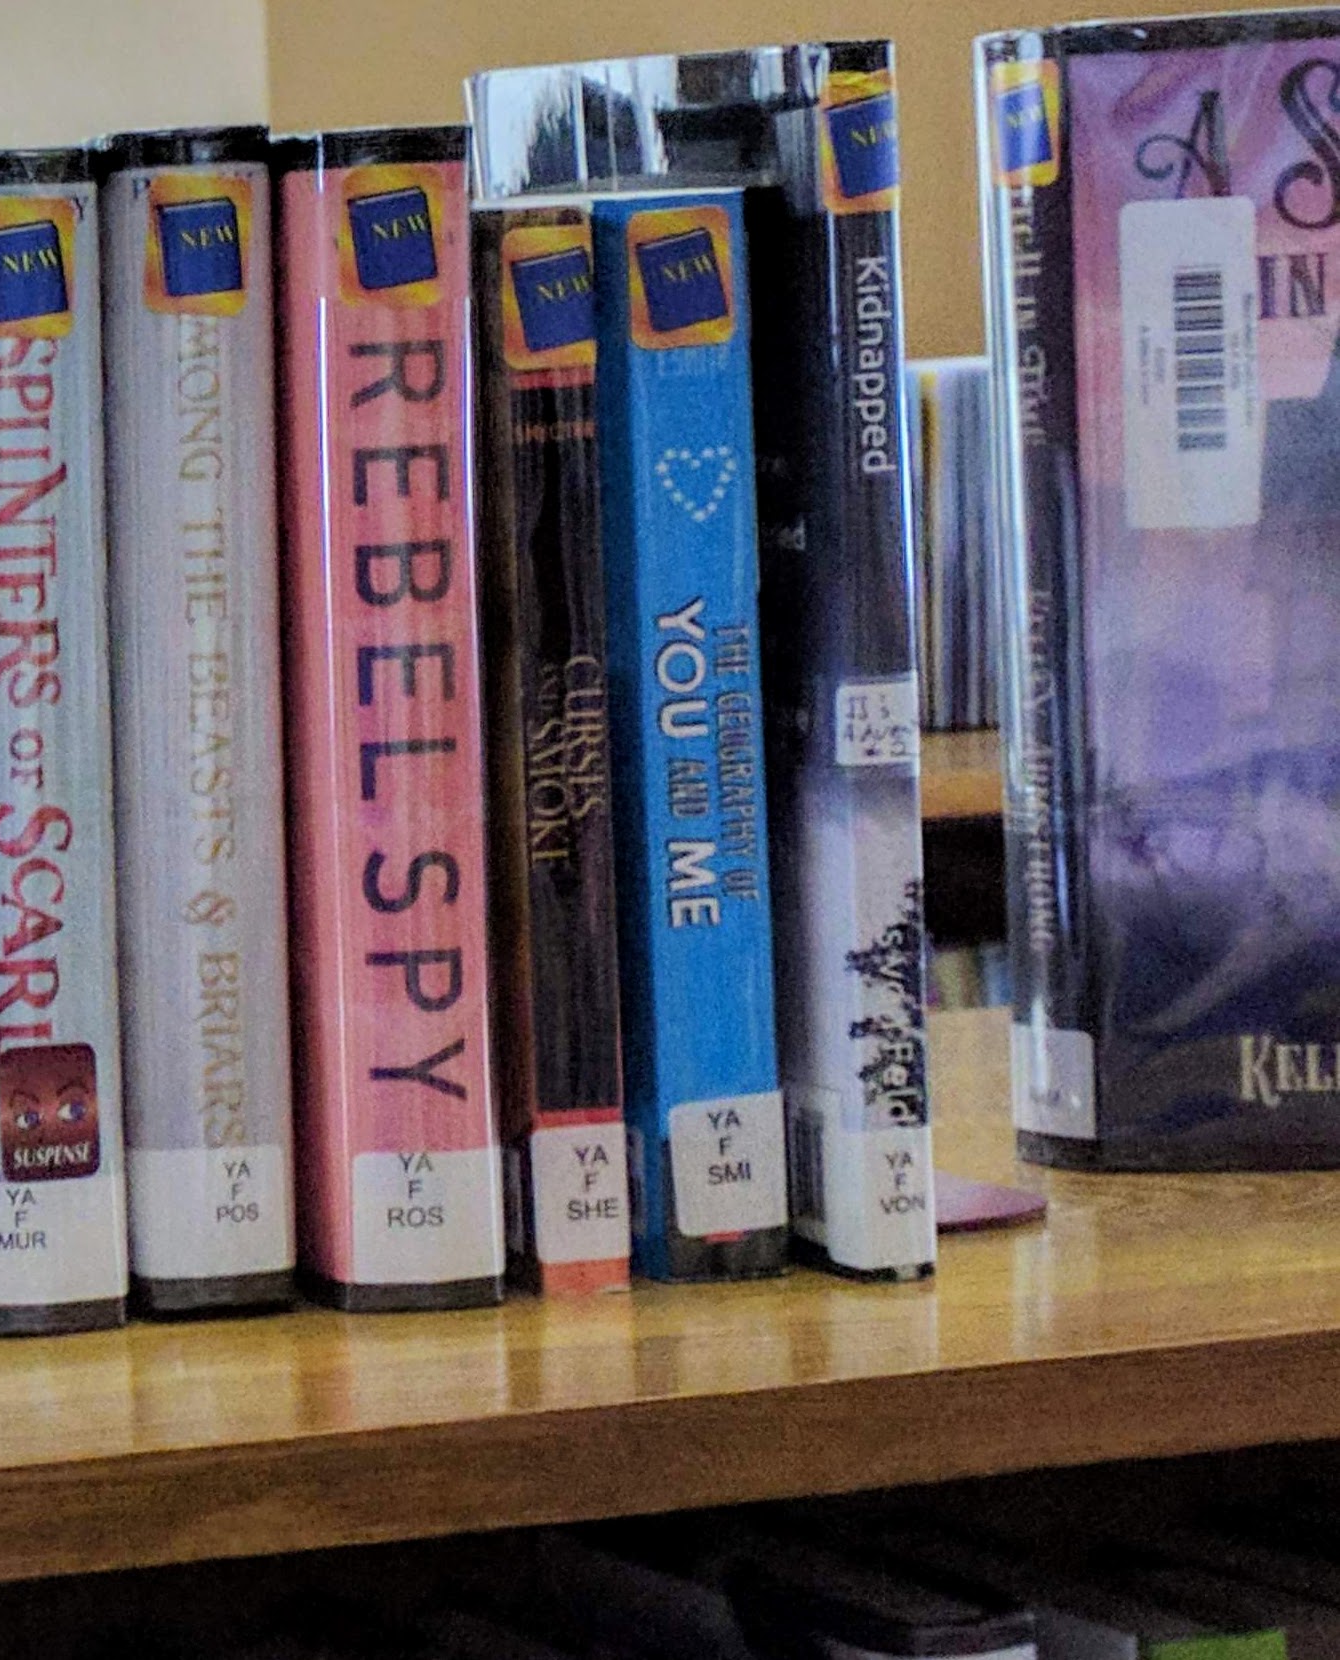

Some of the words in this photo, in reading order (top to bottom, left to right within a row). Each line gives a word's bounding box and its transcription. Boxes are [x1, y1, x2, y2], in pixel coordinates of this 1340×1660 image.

[373, 212, 429, 239] NEW
[180, 227, 234, 249] NEW
[2, 251, 59, 273] NEW
[661, 254, 717, 283] NEW
[535, 274, 590, 302] NEW
[853, 255, 898, 475] Kidnapped
[180, 508, 229, 626] THE
[656, 596, 708, 740] YOU
[667, 761, 708, 820] AND
[669, 840, 720, 929] ME
[1239, 1032, 1340, 1110] KELL
[706, 1111, 741, 1131] YA
[12, 1145, 90, 1167] SUSPENSE
[574, 1146, 607, 1166] YA
[719, 1137, 732, 1155] F
[224, 1161, 250, 1179] YA
[399, 1155, 434, 1173] YA
[885, 1152, 913, 1169] YA
[583, 1173, 598, 1191] F
[707, 1163, 752, 1184] SMI
[894, 1174, 906, 1189] F
[6, 1189, 36, 1208] YA
[232, 1184, 244, 1200] F
[408, 1180, 422, 1199] F
[14, 1211, 28, 1227] F
[217, 1204, 258, 1223] POS
[387, 1207, 444, 1227] ROS
[566, 1200, 619, 1221] SHE
